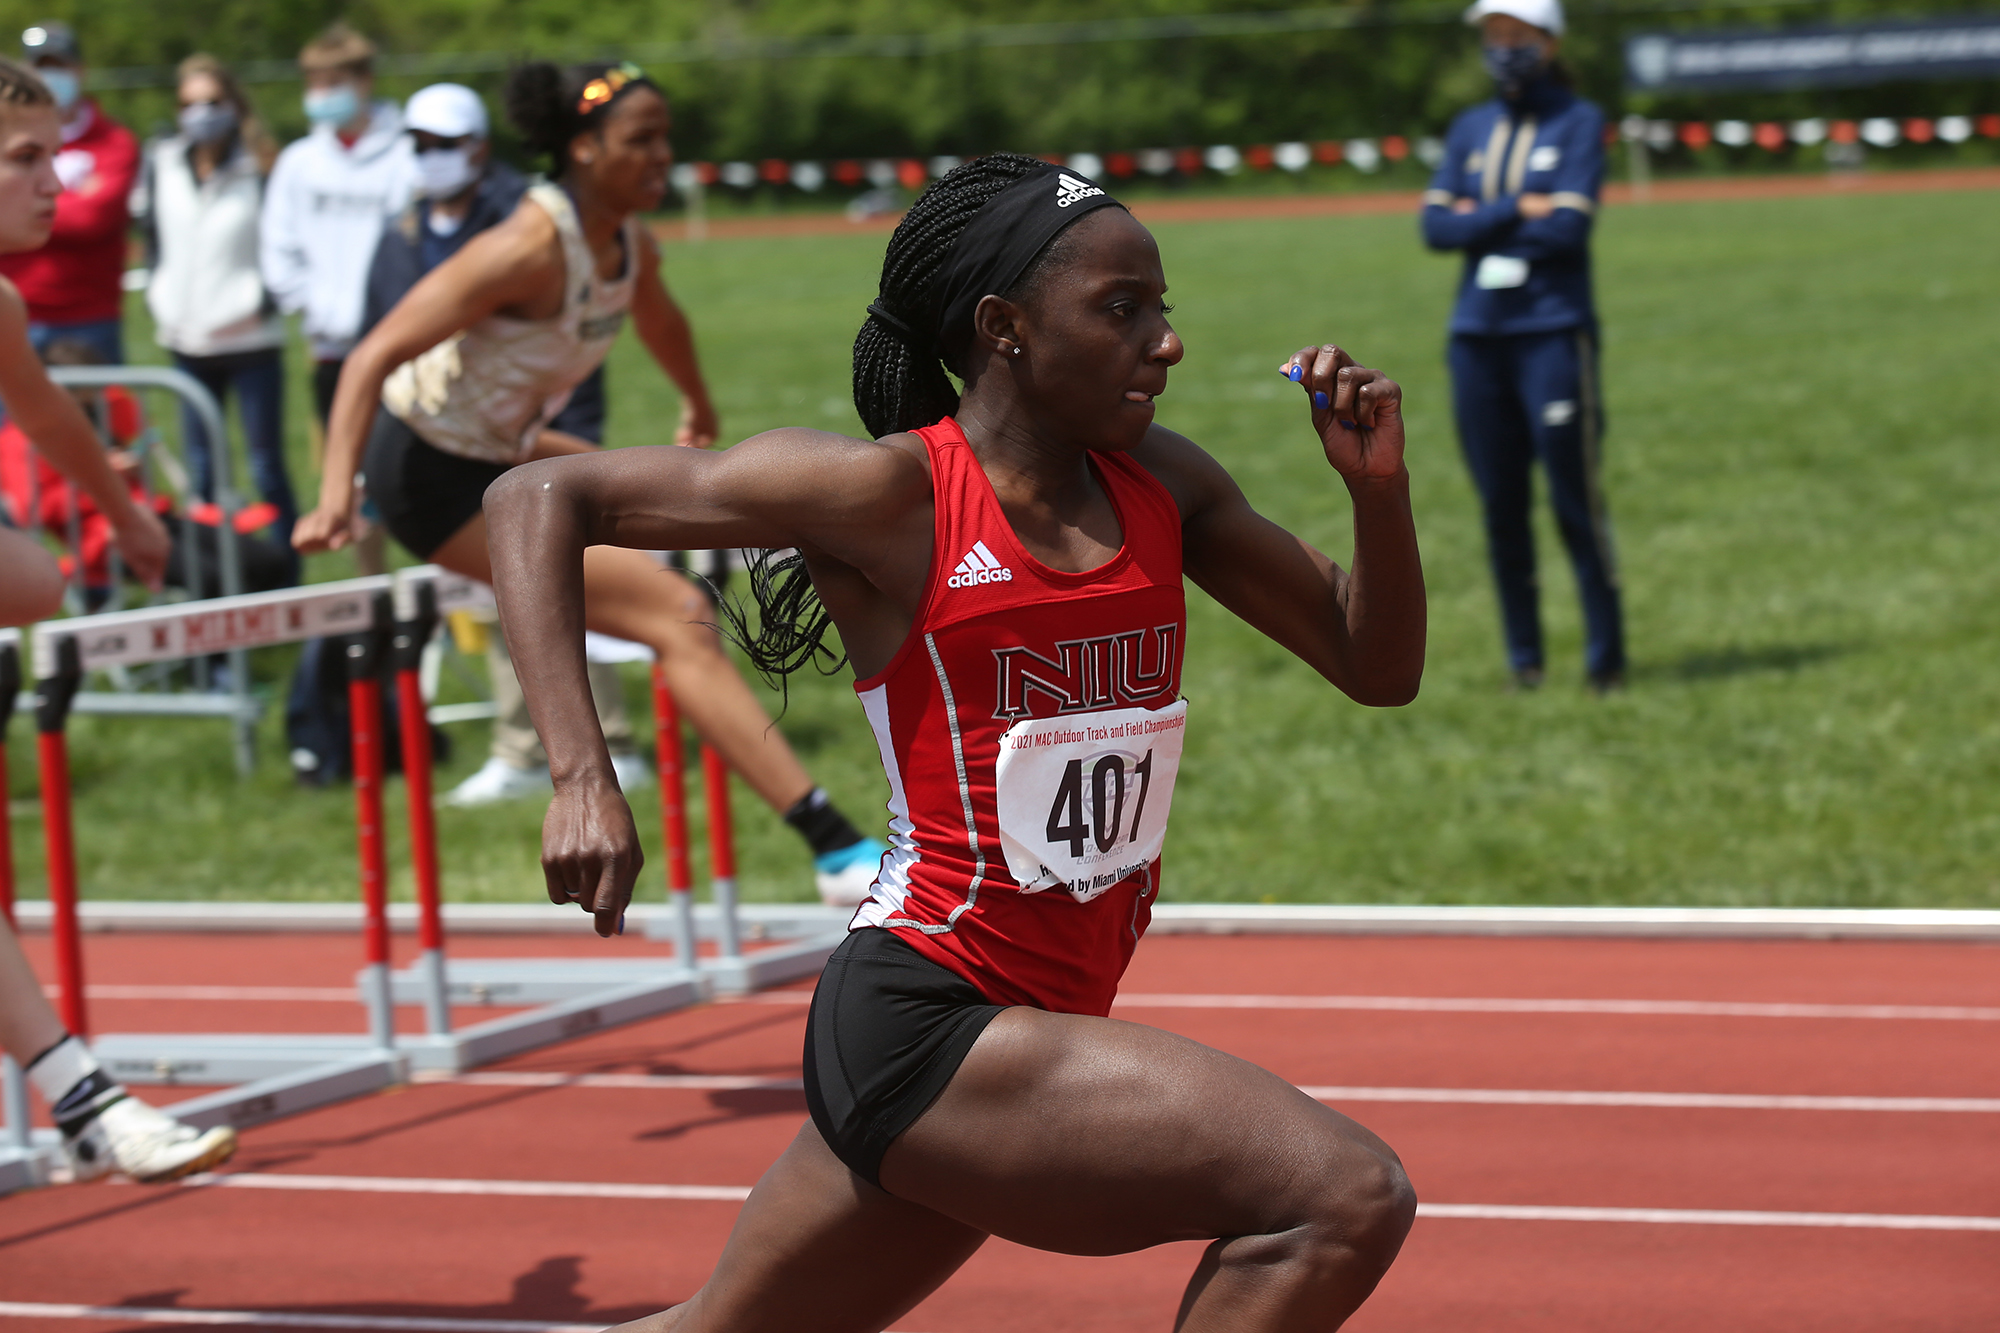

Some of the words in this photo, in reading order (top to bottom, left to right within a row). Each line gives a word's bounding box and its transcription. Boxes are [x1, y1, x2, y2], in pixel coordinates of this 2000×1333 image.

[1057, 187, 1105, 208] adidas
[947, 566, 1013, 589] adidas
[991, 622, 1178, 719] NIU
[1011, 734, 1033, 750] 2021
[1034, 731, 1052, 747] MAC
[1054, 728, 1085, 745] Outdoor
[1087, 725, 1109, 741] Track
[1111, 723, 1124, 738] and
[1126, 720, 1143, 736] Field
[1144, 714, 1185, 734] Championships
[1046, 748, 1153, 858] 401
[1078, 879, 1090, 893] by
[1092, 870, 1116, 889] Miami
